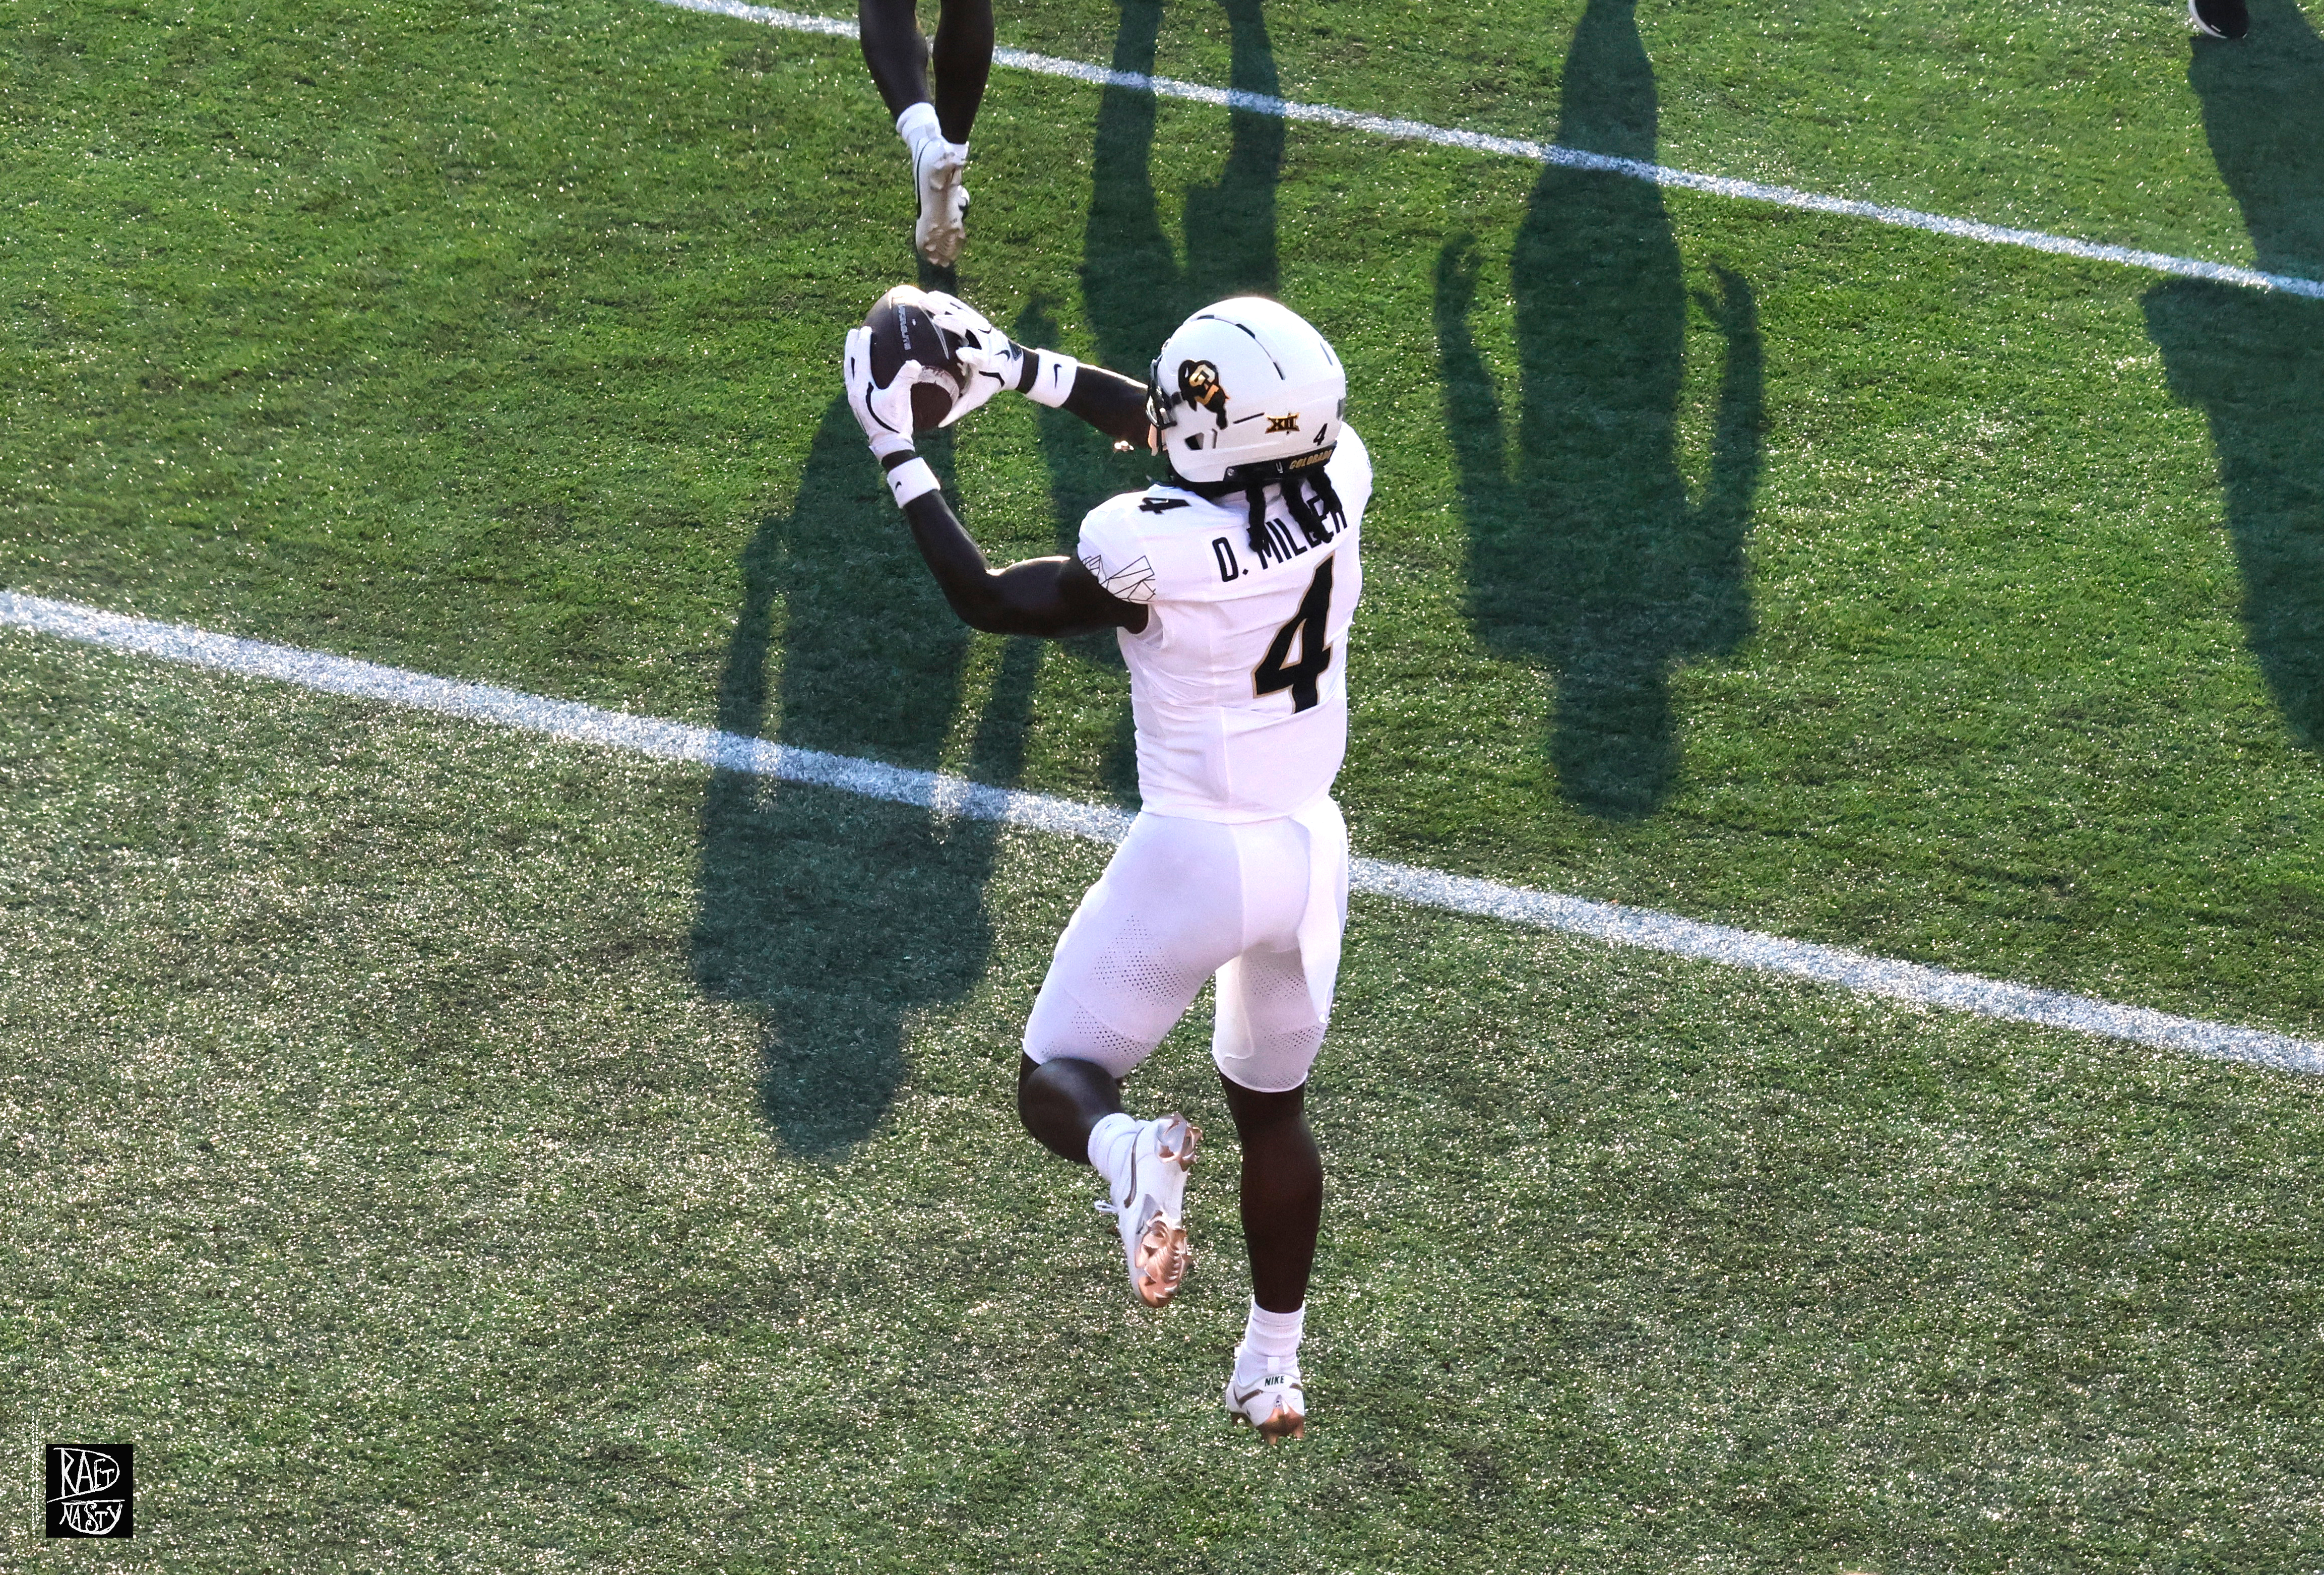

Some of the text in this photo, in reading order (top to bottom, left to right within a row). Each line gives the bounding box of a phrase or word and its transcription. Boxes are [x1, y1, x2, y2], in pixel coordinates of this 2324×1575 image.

[1313, 423, 1328, 446] 4
[1138, 497, 1191, 515] 4
[1212, 537, 1249, 582] D.
[1251, 550, 1336, 714] 4
[1264, 1375, 1285, 1387] NIKE
